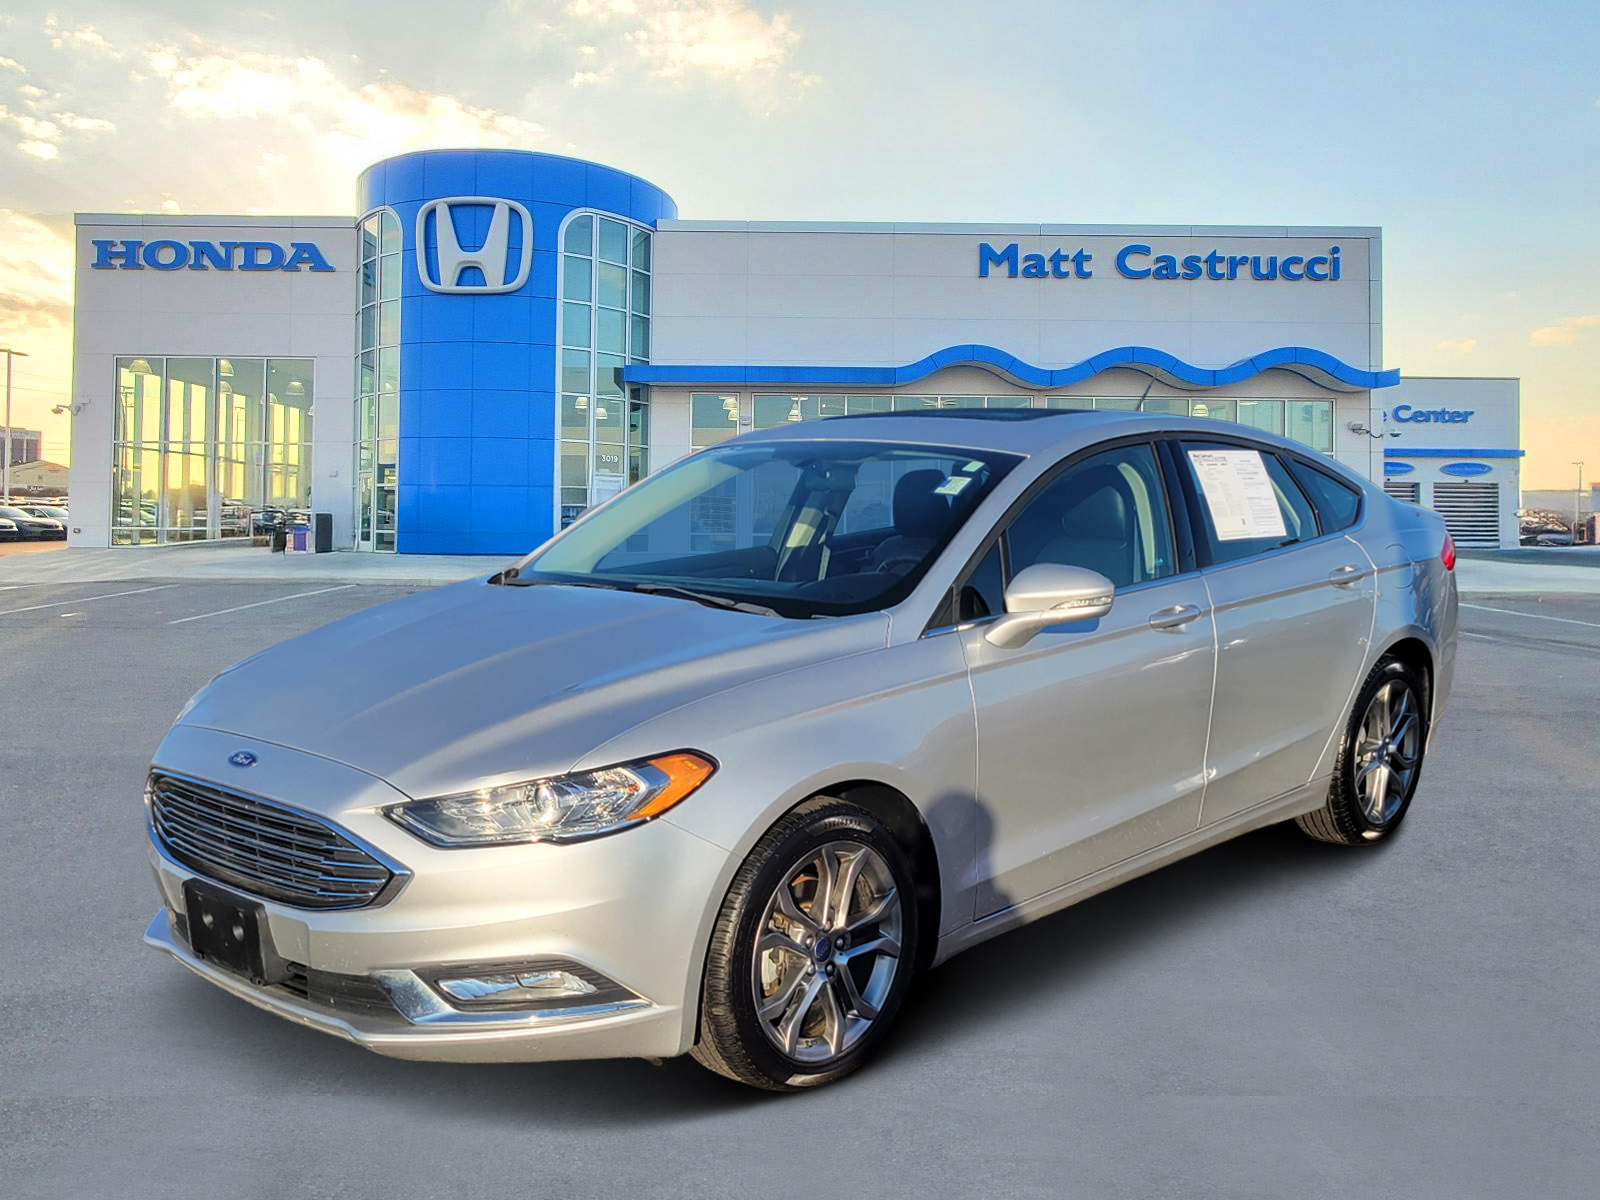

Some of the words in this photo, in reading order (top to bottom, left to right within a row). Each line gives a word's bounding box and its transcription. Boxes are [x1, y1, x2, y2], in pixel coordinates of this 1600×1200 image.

[91, 239, 336, 272] HONDA
[978, 242, 1093, 279] Matt
[1115, 243, 1341, 281] Castrucci
[1391, 404, 1475, 424] Center
[601, 454, 618, 463] 3019
